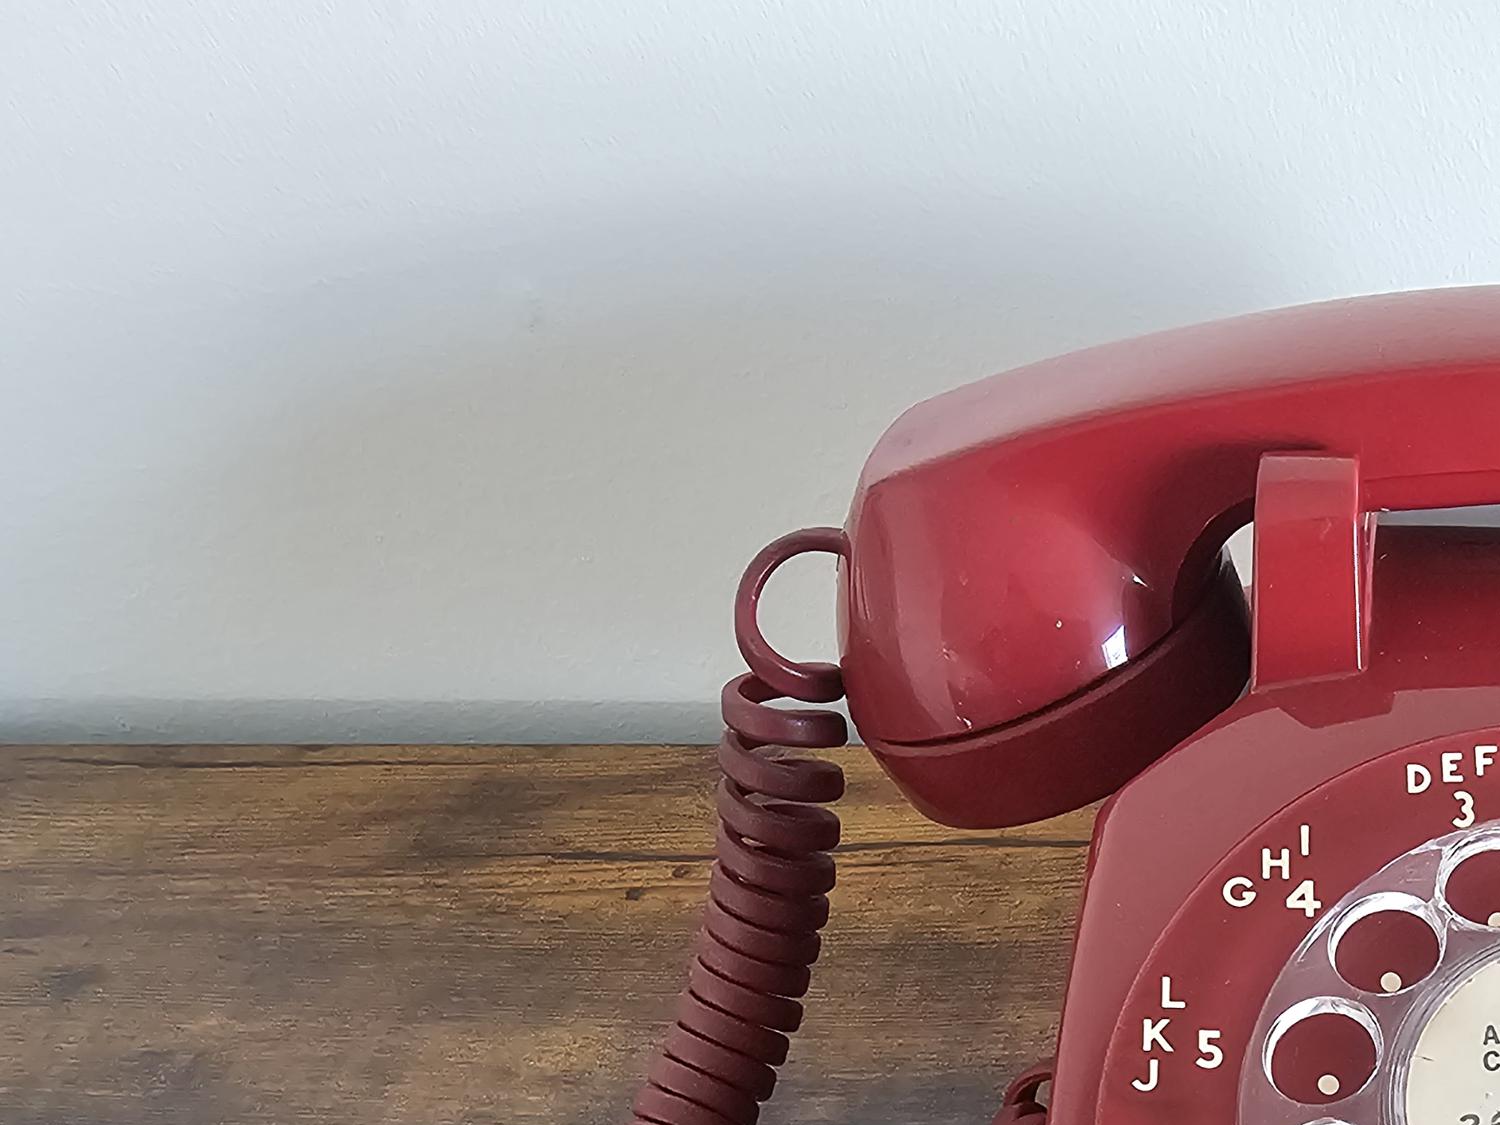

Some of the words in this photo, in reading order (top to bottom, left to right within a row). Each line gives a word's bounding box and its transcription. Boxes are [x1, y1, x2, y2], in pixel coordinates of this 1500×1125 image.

[1406, 745, 1499, 795] DEF
[1452, 790, 1476, 829] 3
[1285, 879, 1322, 918] 4
[1195, 1029, 1223, 1069] 5
